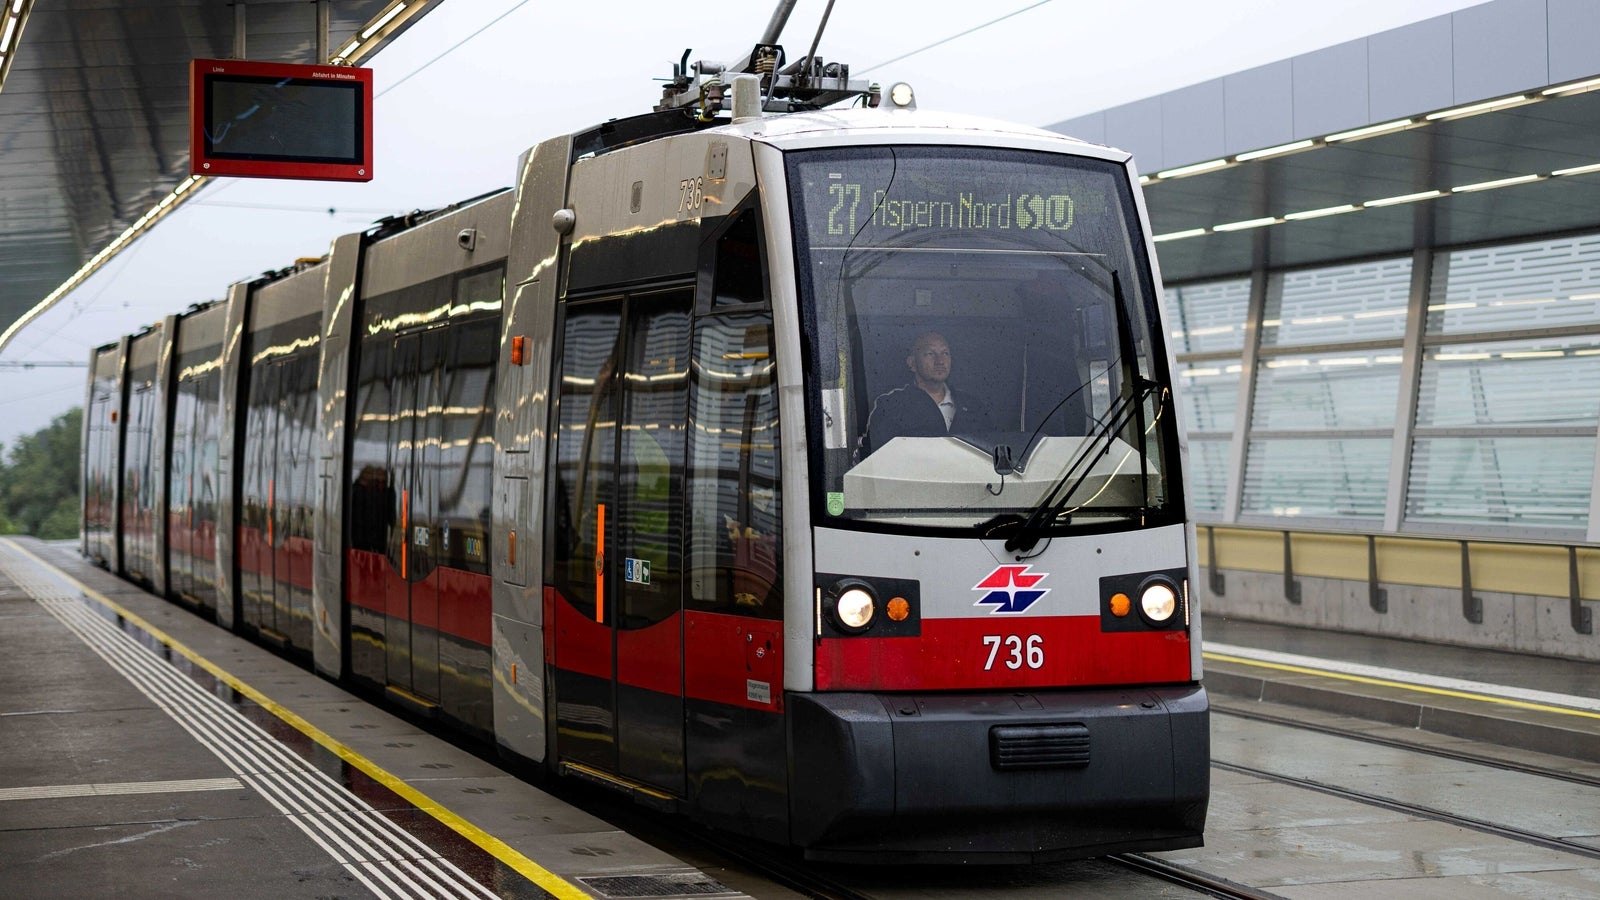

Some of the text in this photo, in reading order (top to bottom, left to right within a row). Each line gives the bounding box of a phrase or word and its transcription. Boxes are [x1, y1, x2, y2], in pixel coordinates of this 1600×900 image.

[678, 176, 703, 214] 736
[828, 183, 861, 235] 27
[873, 189, 953, 232] Aspern
[959, 192, 1011, 230] Nord
[982, 634, 1045, 671] 736
